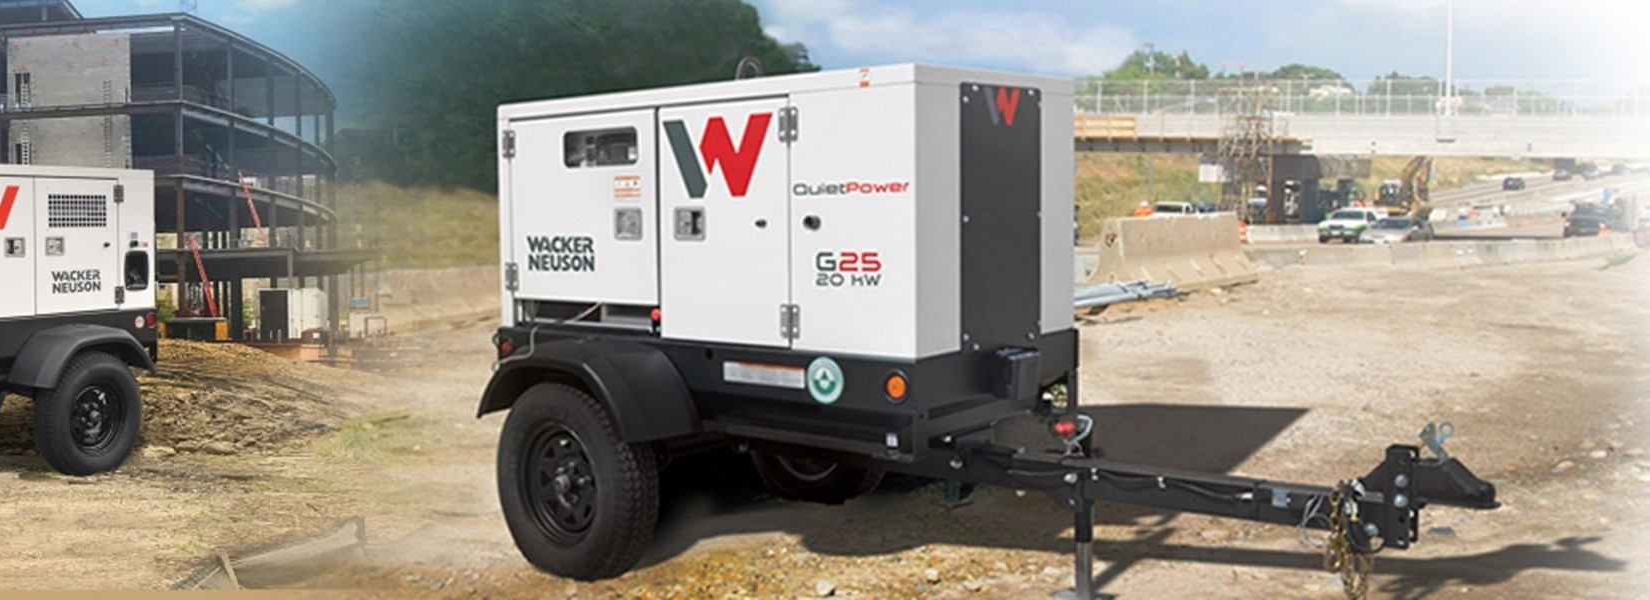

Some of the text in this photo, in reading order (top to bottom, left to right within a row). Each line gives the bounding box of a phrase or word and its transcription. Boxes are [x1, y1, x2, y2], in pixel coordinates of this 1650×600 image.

[526, 235, 595, 253] WACKER
[528, 254, 595, 271] NEUSON
[815, 251, 882, 272] G25
[51, 269, 101, 281] WACKER
[815, 272, 845, 287] 20
[52, 281, 101, 294] NEUSON
